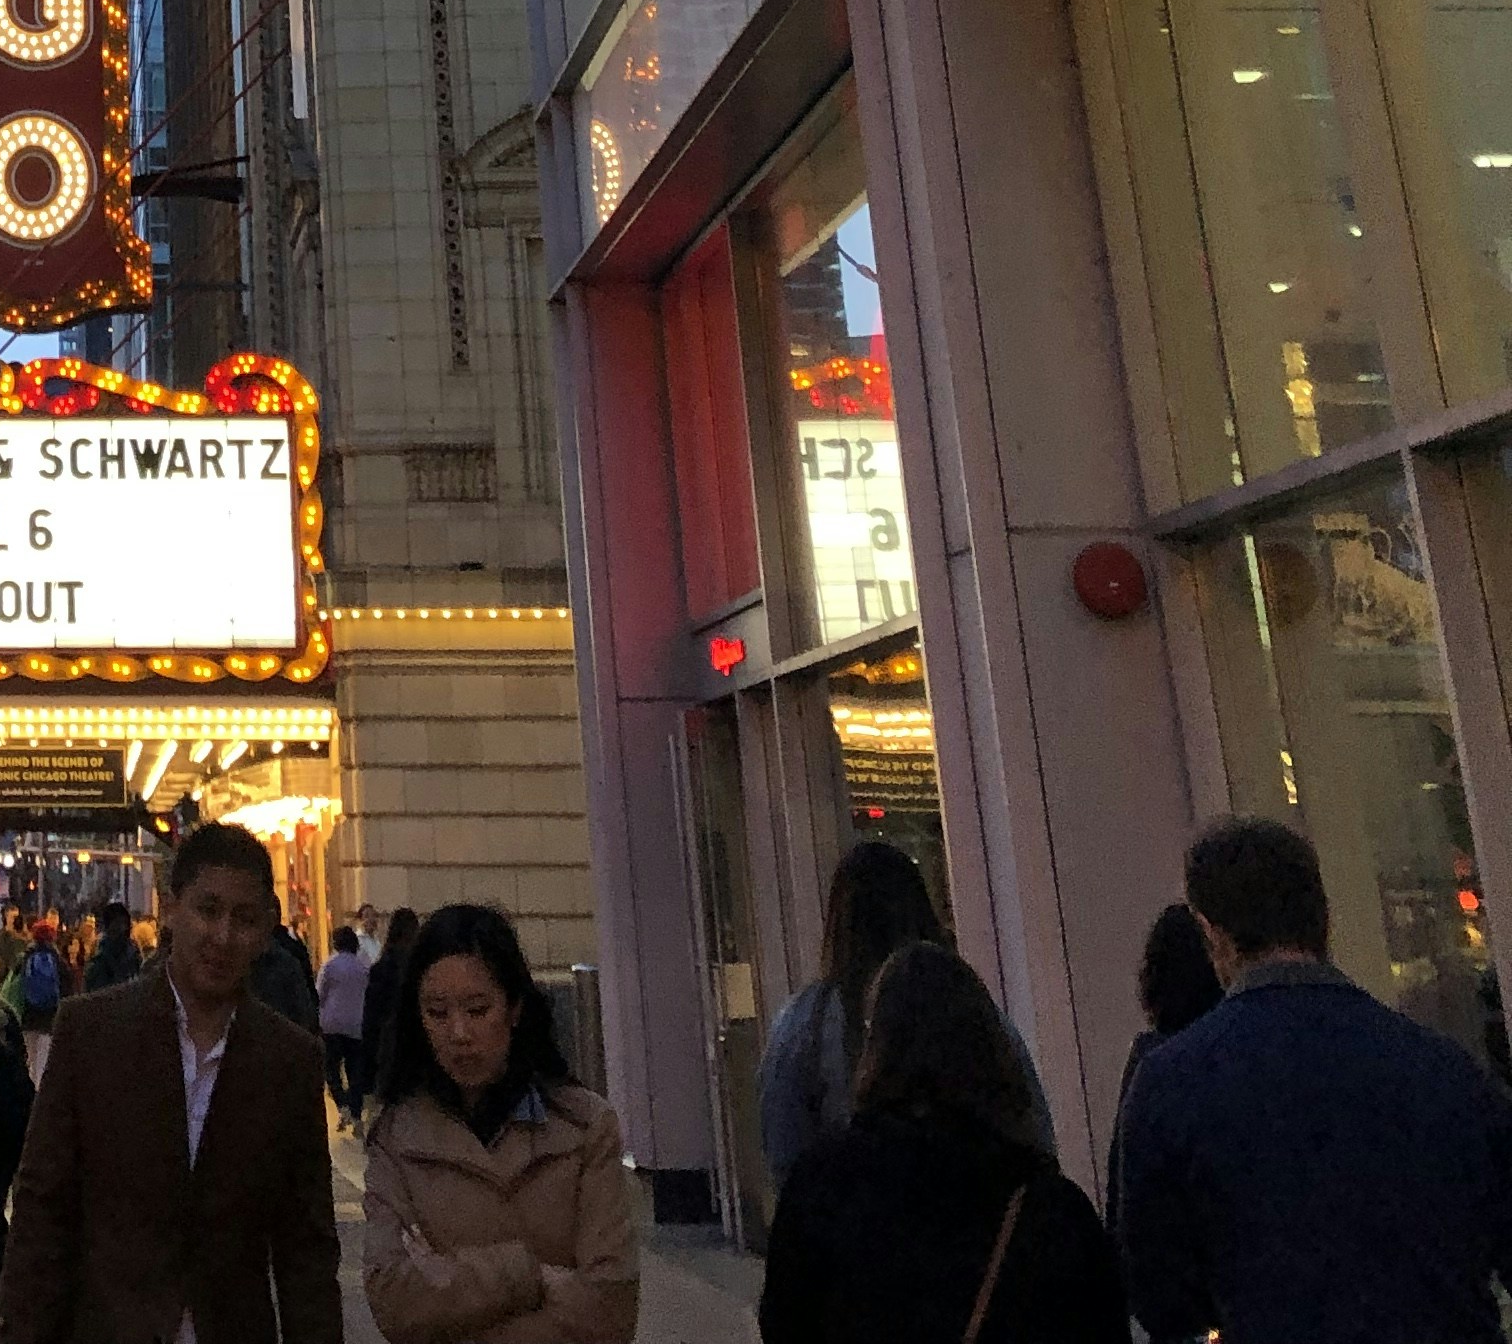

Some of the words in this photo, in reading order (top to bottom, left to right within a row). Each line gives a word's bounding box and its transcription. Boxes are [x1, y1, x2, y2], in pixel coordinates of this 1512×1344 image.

[38, 438, 288, 480] SCHWARTZ
[28, 509, 53, 550] 6
[31, 757, 50, 768] THE
[51, 757, 88, 768] SCENES
[89, 757, 104, 768] OF
[22, 771, 68, 782] CHICAGO
